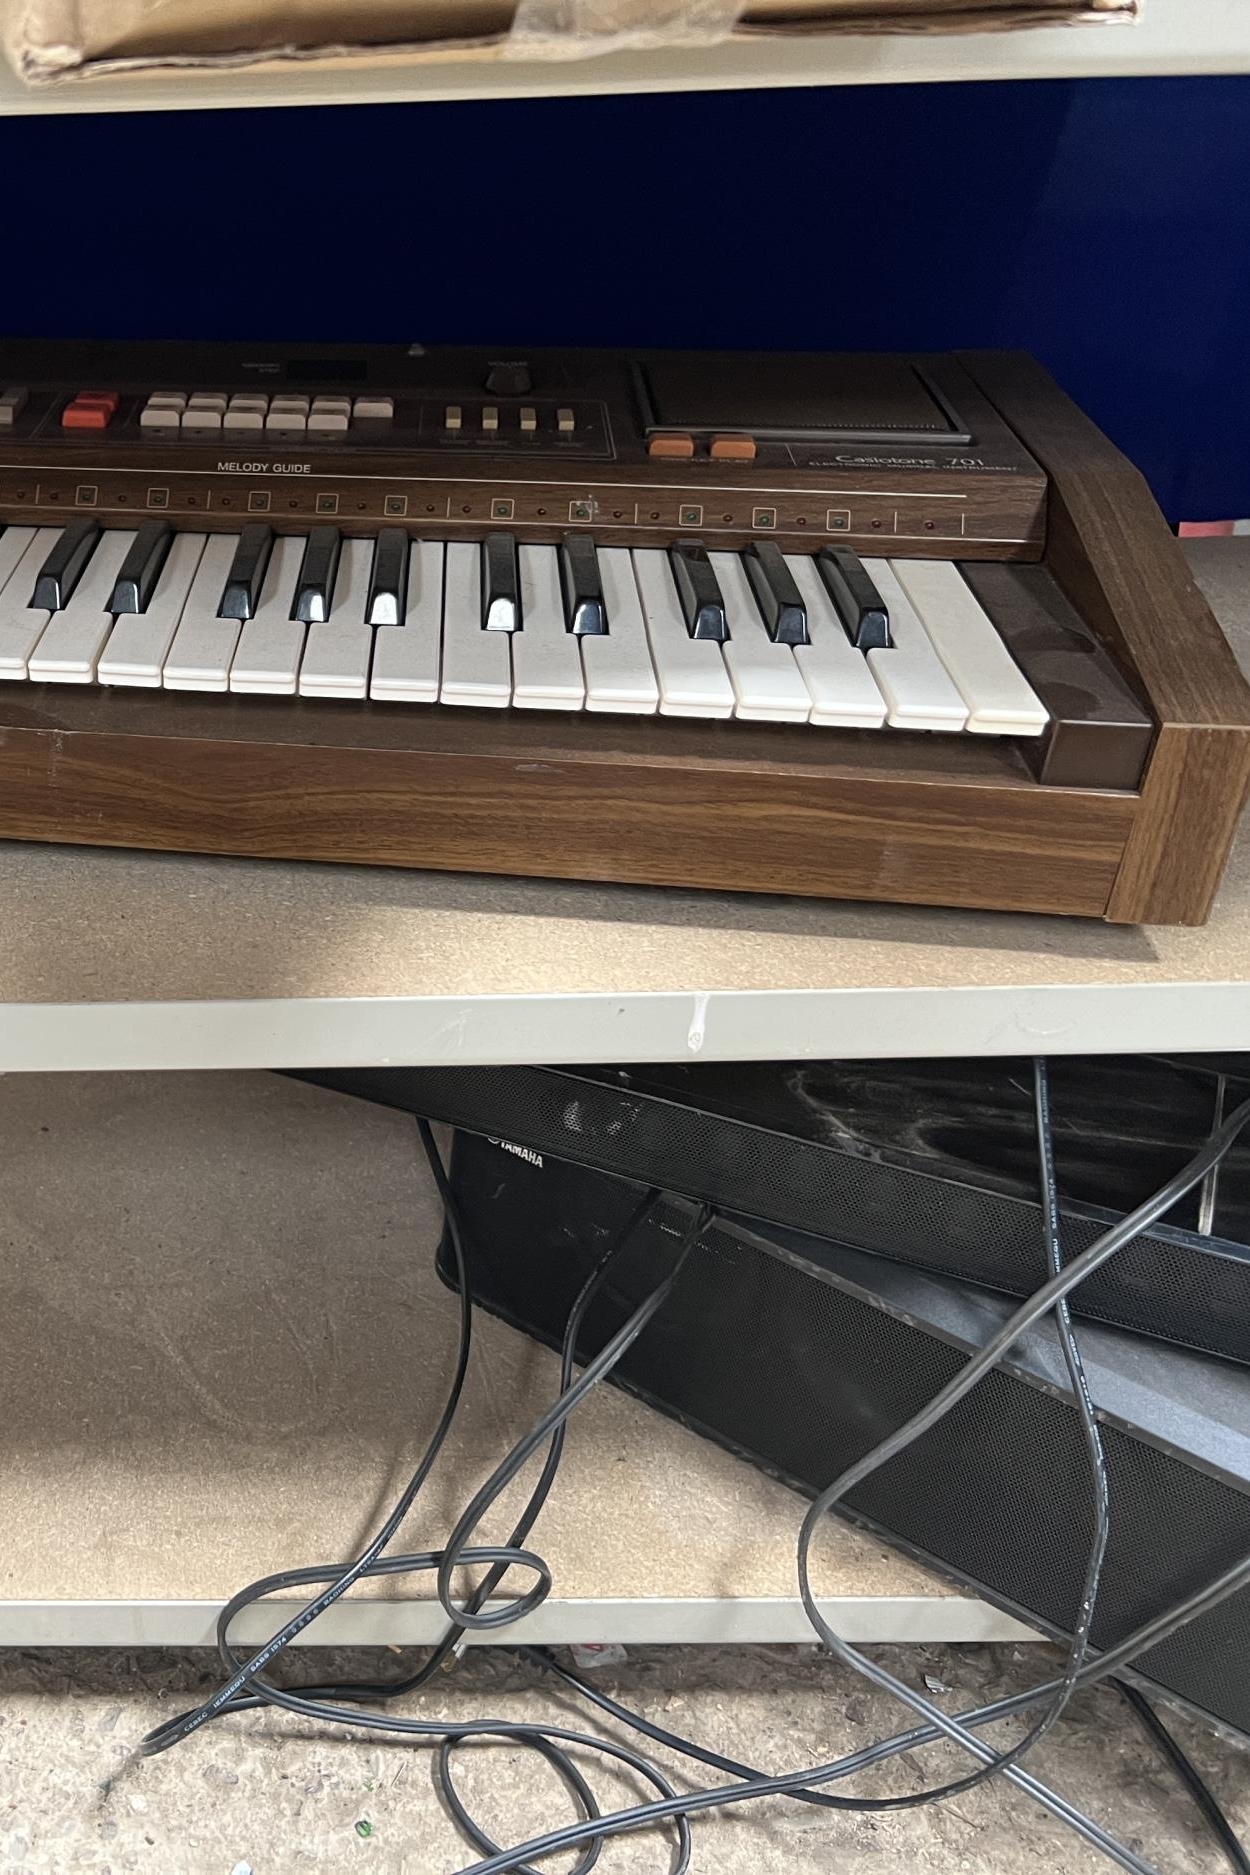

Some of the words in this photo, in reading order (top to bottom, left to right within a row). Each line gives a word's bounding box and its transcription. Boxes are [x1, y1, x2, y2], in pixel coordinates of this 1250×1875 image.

[835, 455, 936, 465] Casiotone
[945, 458, 984, 466] 701
[217, 462, 269, 472] MELODY
[272, 463, 311, 473] GUIDE
[184, 1711, 208, 1732] CEBEC
[250, 1652, 269, 1672] SABS
